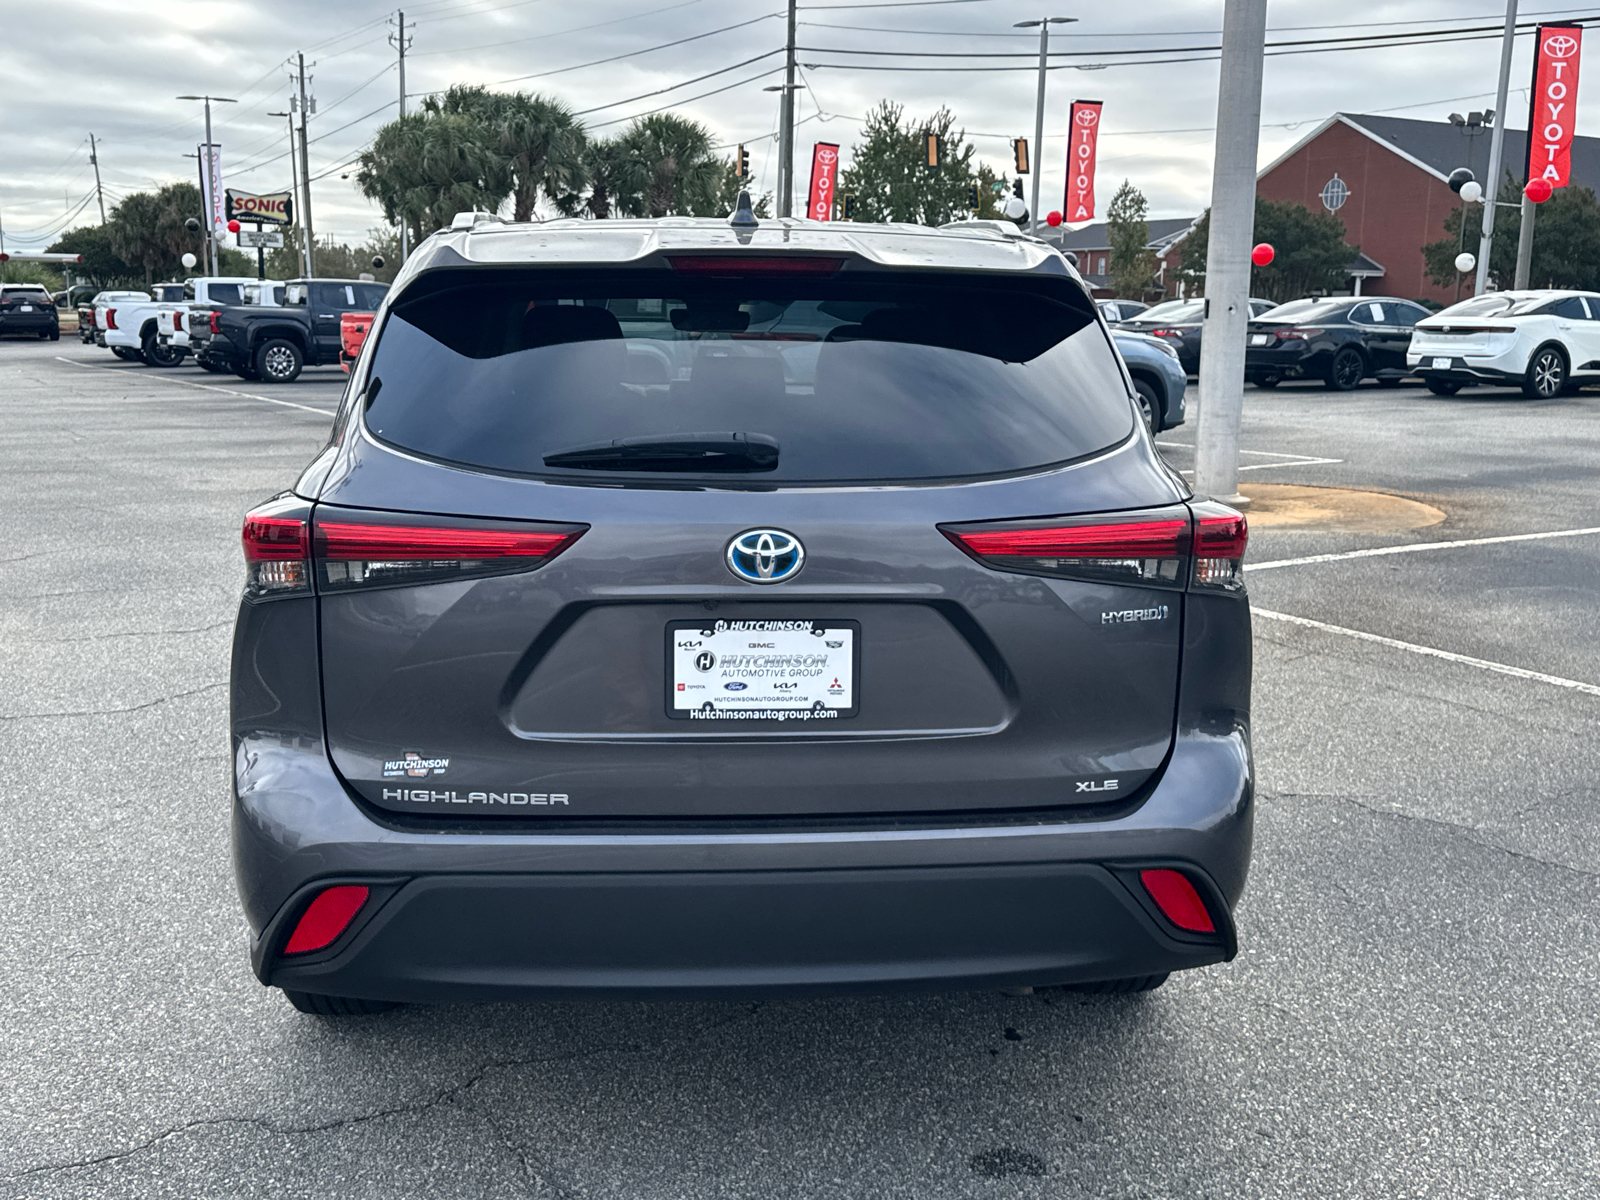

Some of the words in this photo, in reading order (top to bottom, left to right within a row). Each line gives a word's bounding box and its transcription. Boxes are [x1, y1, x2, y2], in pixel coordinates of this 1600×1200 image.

[1542, 62, 1567, 181] TOYOTA
[1075, 129, 1091, 218] TOYOTA
[816, 165, 831, 221] TOYOT
[234, 197, 287, 213] SONIC
[1101, 607, 1161, 625] HYBRID
[730, 621, 814, 631] HUTCHINSON
[719, 654, 829, 669] HUTCHINSON
[721, 669, 786, 678] AUTOMOTIVE
[788, 668, 823, 677] GROUP
[690, 709, 838, 721] Hutchinsonautogroup.com
[384, 759, 450, 770] HUTCHINSON
[1075, 779, 1119, 793] XLE
[382, 788, 570, 806] HIGHLANDER
